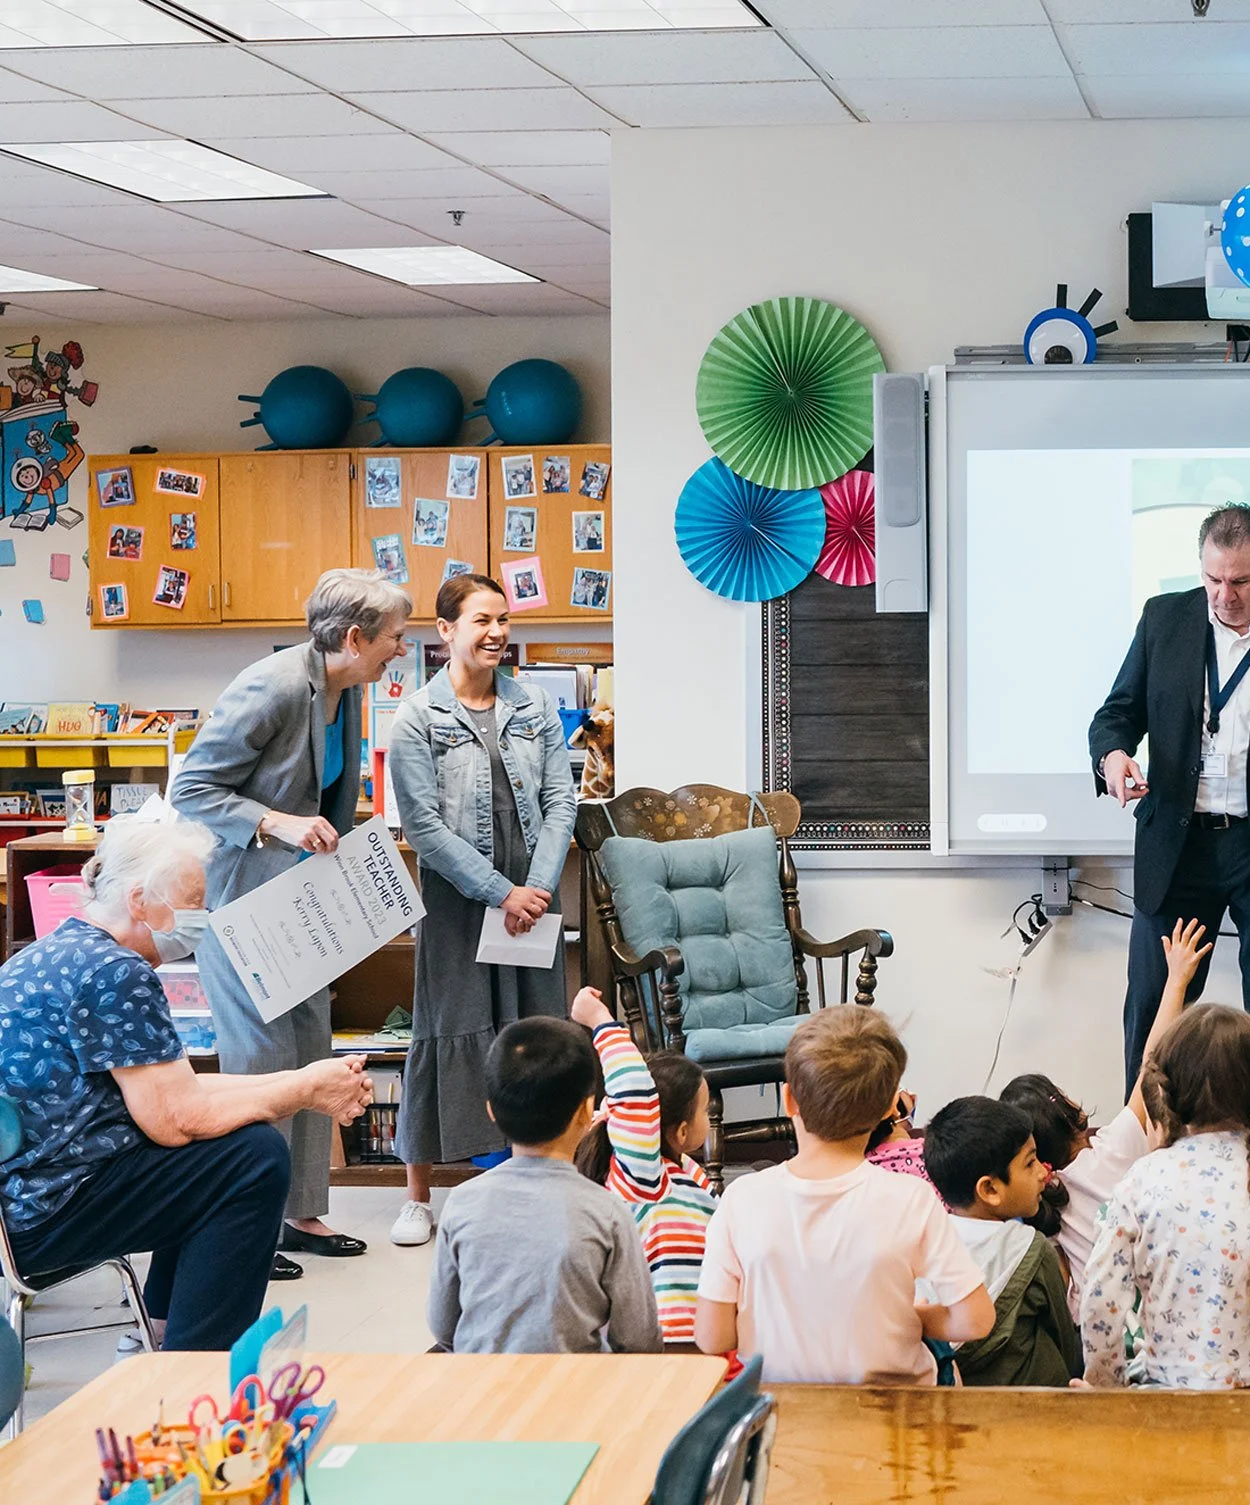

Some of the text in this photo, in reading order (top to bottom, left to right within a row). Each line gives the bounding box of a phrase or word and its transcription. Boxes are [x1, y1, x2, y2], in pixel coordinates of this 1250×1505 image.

[556, 646, 591, 658] Empathy
[58, 720, 82, 733] HUG
[347, 856, 387, 925] AWARD 2023
[363, 854, 395, 910] TEACHER
[368, 831, 413, 917] OUTSTANDING
[292, 897, 311, 928] Kerry
[303, 882, 344, 955] Congratulations
[351, 887, 368, 920] Elementary
[366, 918, 380, 940] School
